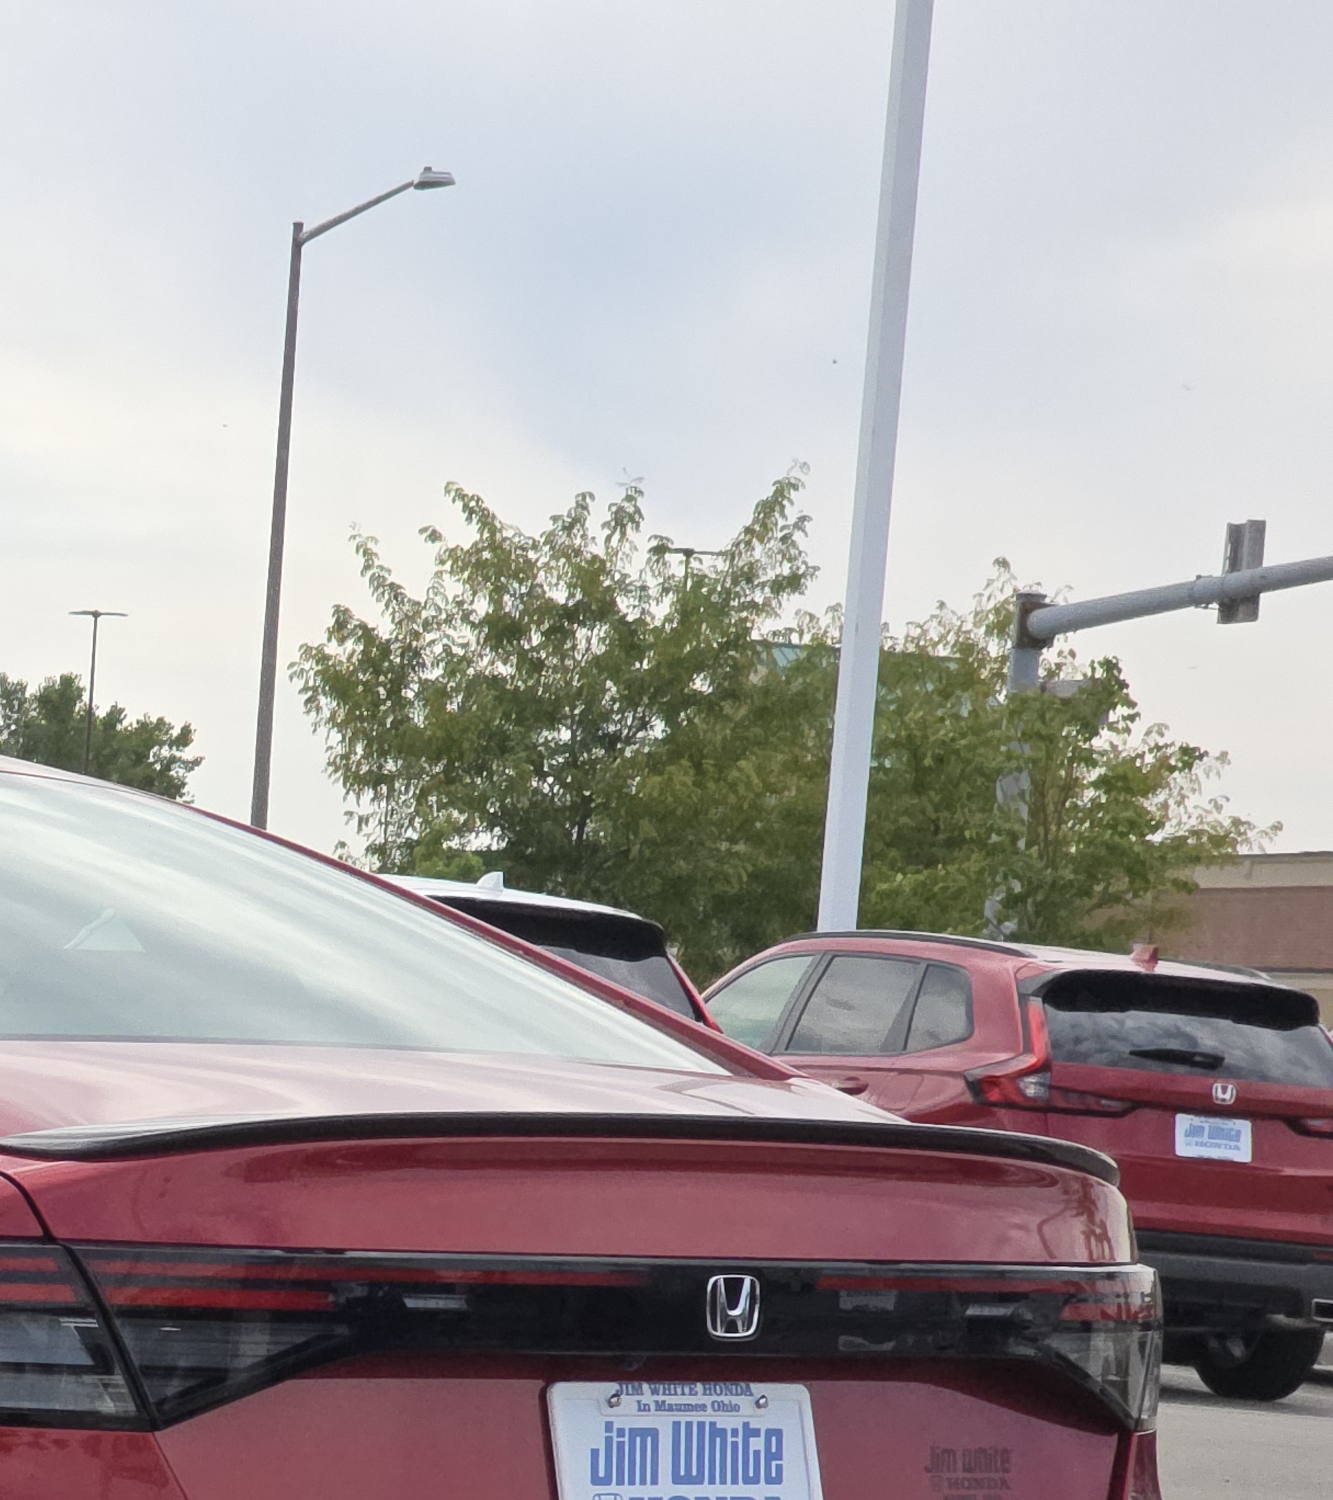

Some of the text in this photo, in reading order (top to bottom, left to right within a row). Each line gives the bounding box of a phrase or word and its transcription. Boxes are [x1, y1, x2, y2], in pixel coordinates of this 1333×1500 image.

[616, 1382, 754, 1397] JIM WHITE HONDA
[636, 1400, 650, 1412] In
[711, 1400, 740, 1412] Ohio
[672, 1421, 784, 1486] White
